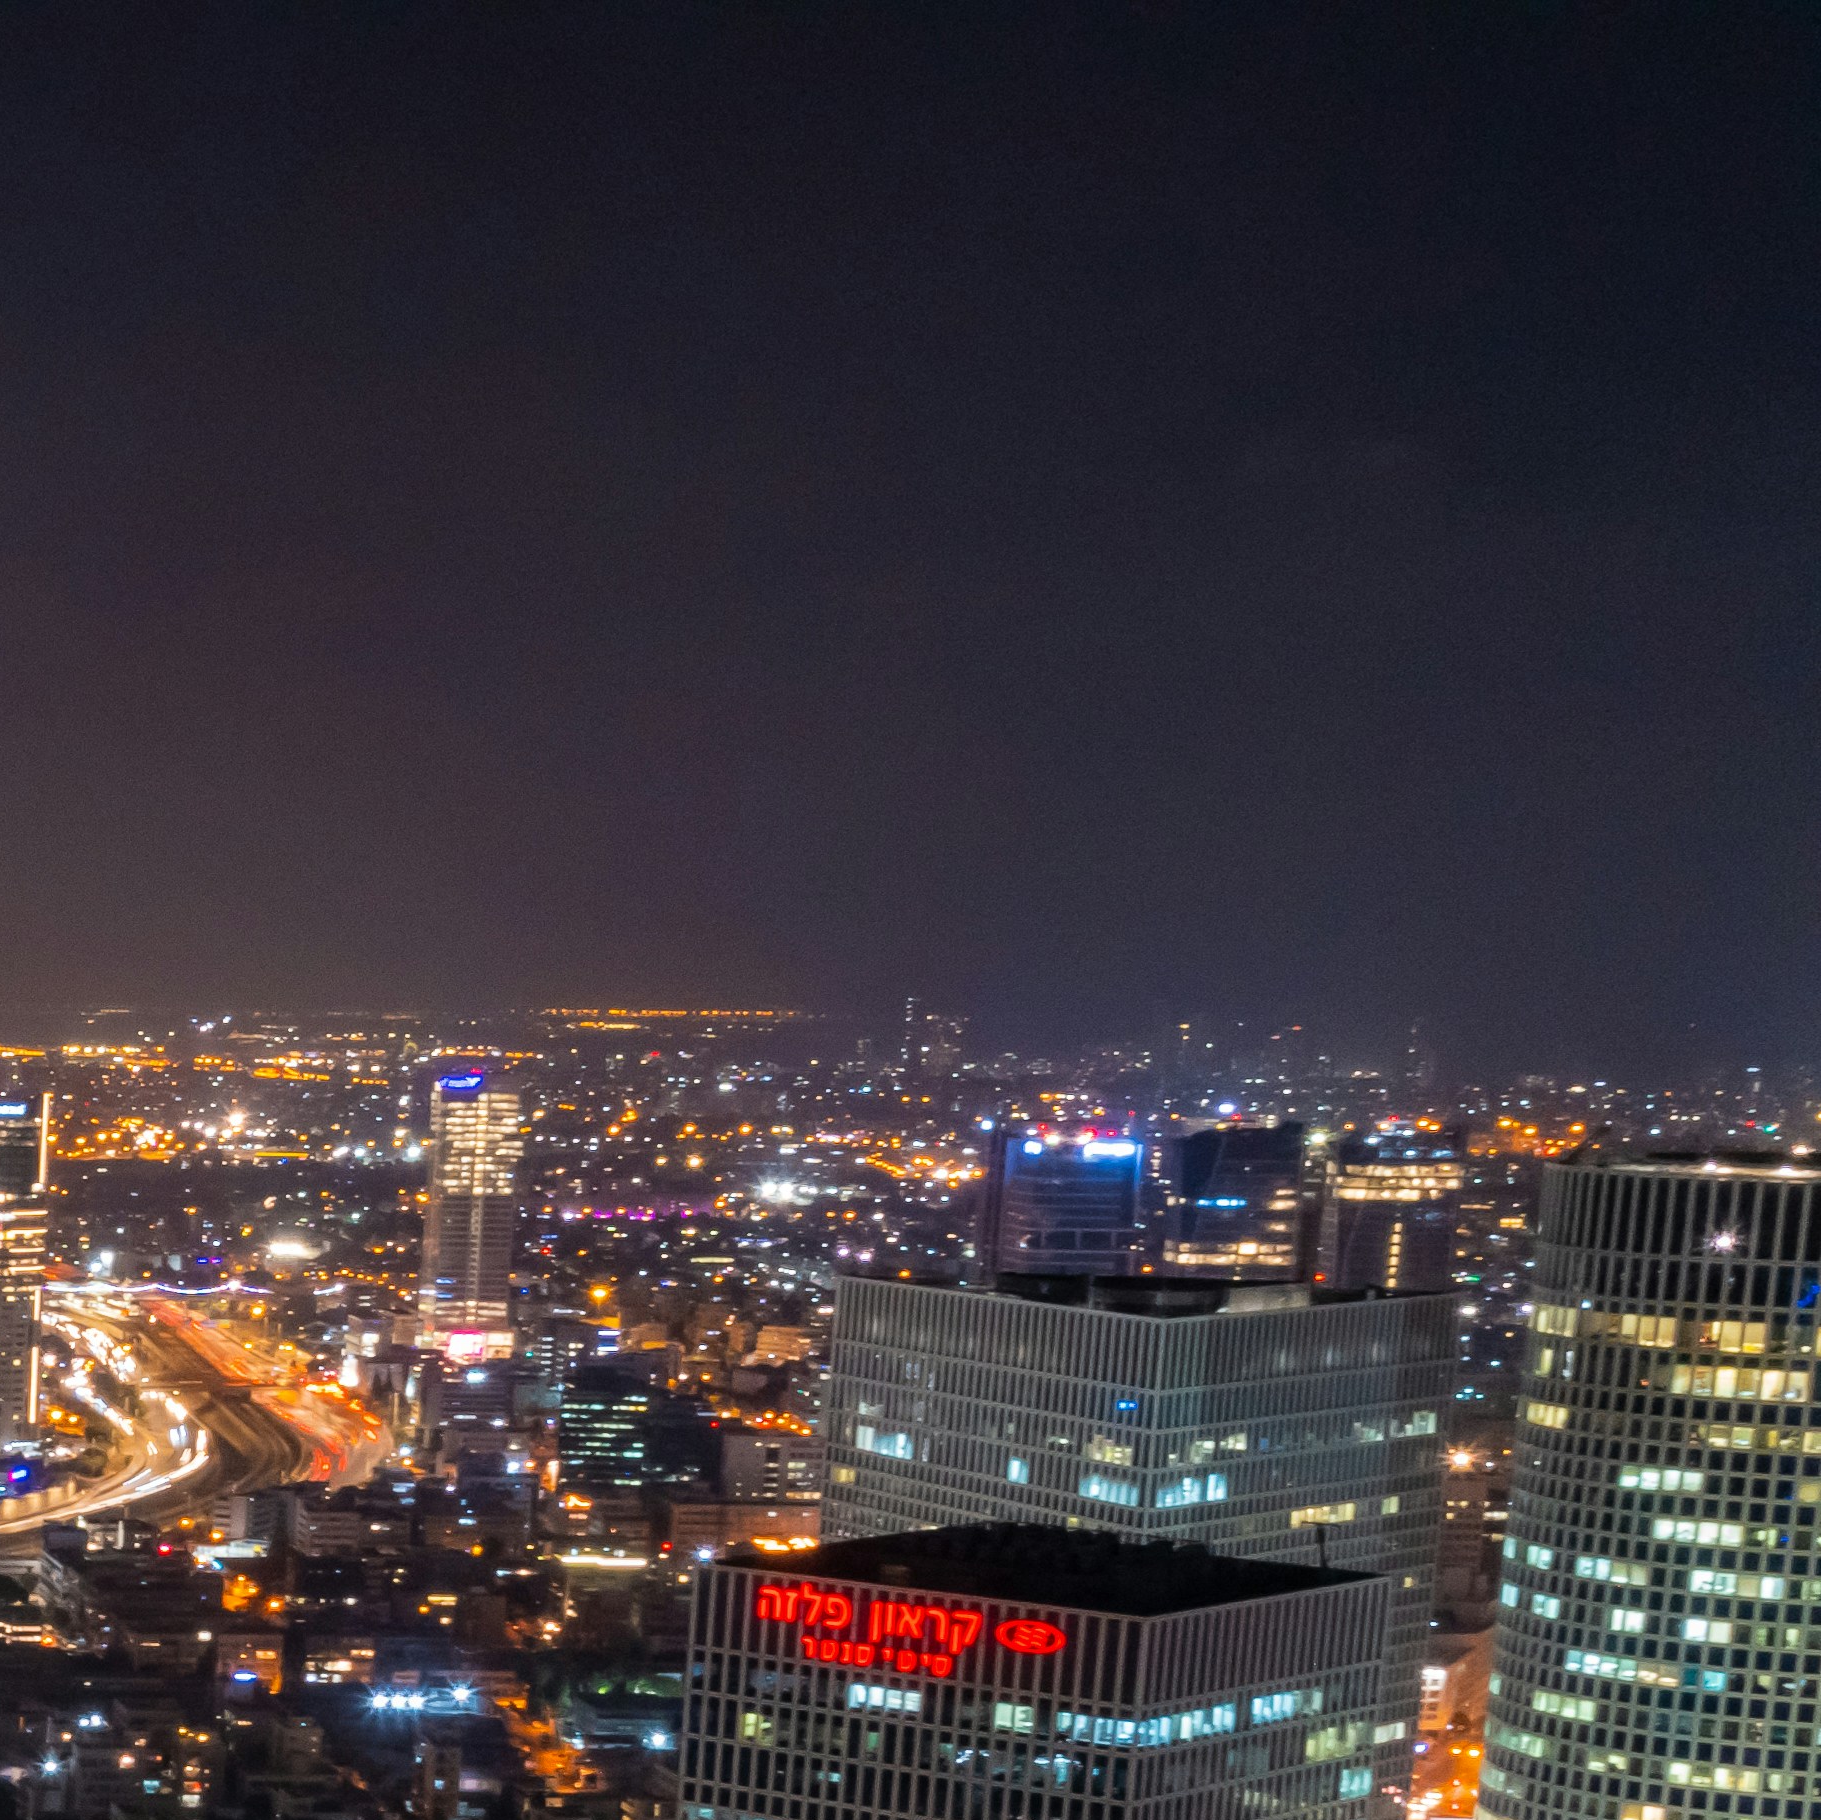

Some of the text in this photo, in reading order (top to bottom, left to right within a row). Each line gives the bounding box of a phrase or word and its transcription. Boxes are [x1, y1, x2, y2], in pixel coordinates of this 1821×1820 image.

[757, 1582, 982, 1655] קראון פלזה
[801, 1635, 875, 1667] סנטר
